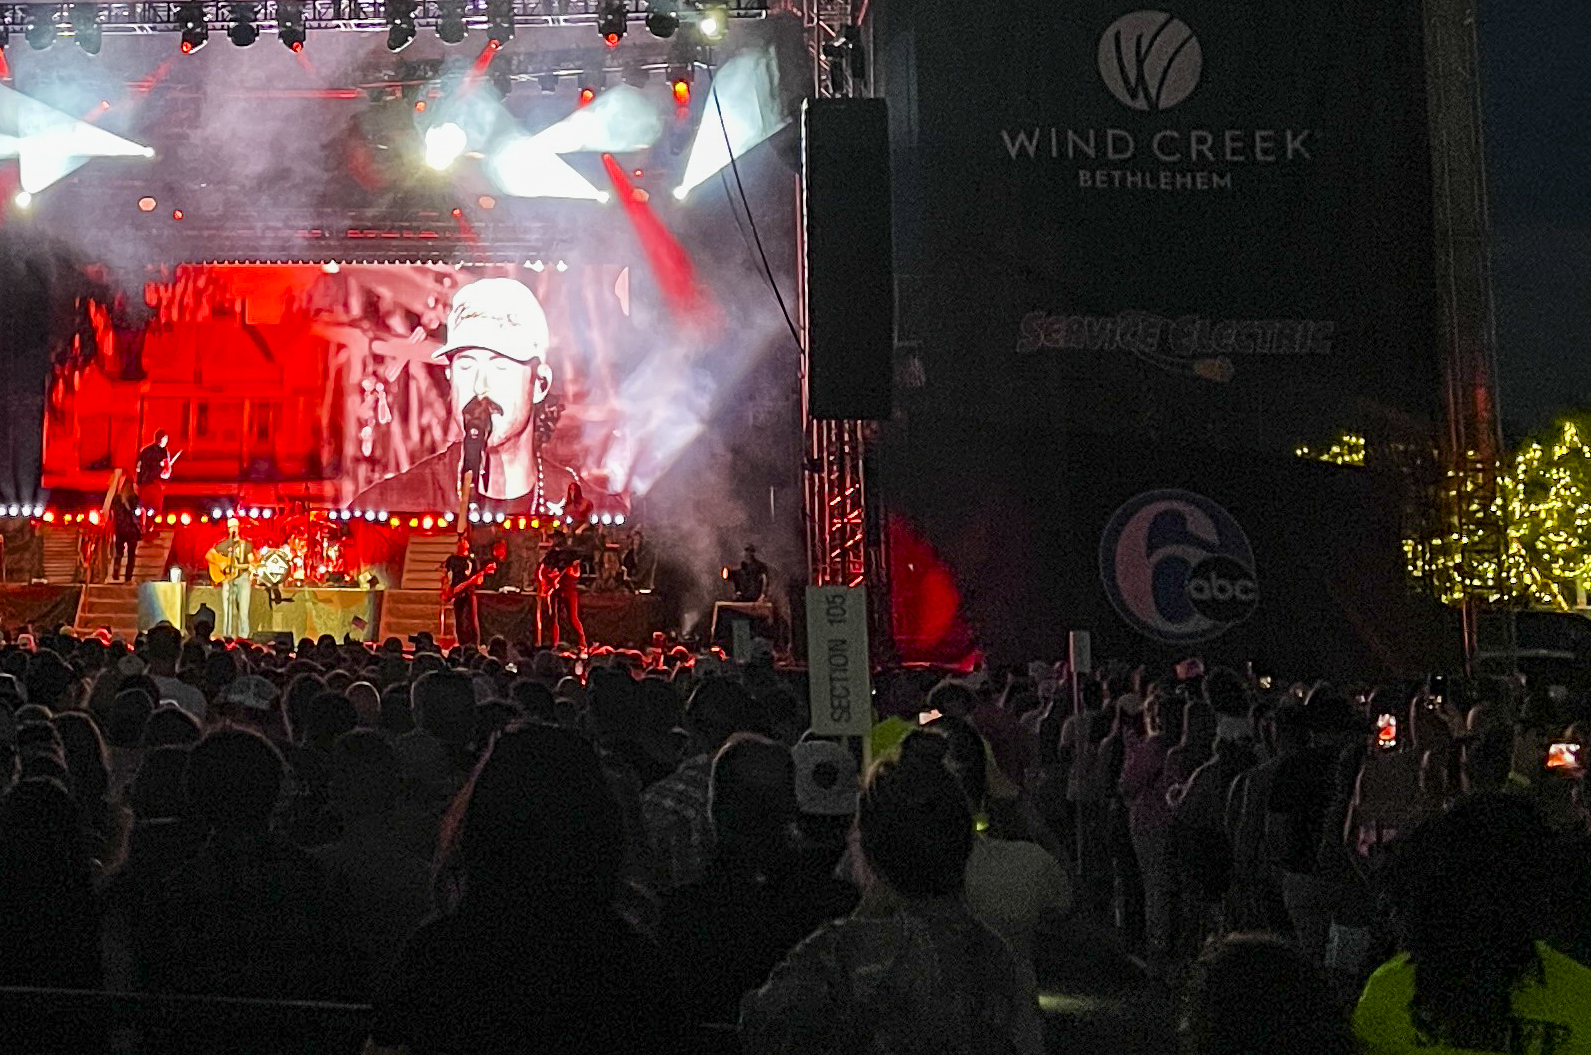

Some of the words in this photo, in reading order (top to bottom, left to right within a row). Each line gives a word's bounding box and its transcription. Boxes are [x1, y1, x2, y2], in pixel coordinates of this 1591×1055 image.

[1000, 127, 1136, 161] WIND
[1152, 128, 1312, 163] CREEK
[1078, 169, 1233, 190] BETHLEHEM
[1114, 499, 1221, 635] 6
[1187, 571, 1257, 600] abc
[826, 594, 847, 626] 105
[828, 639, 851, 723] SECTION
